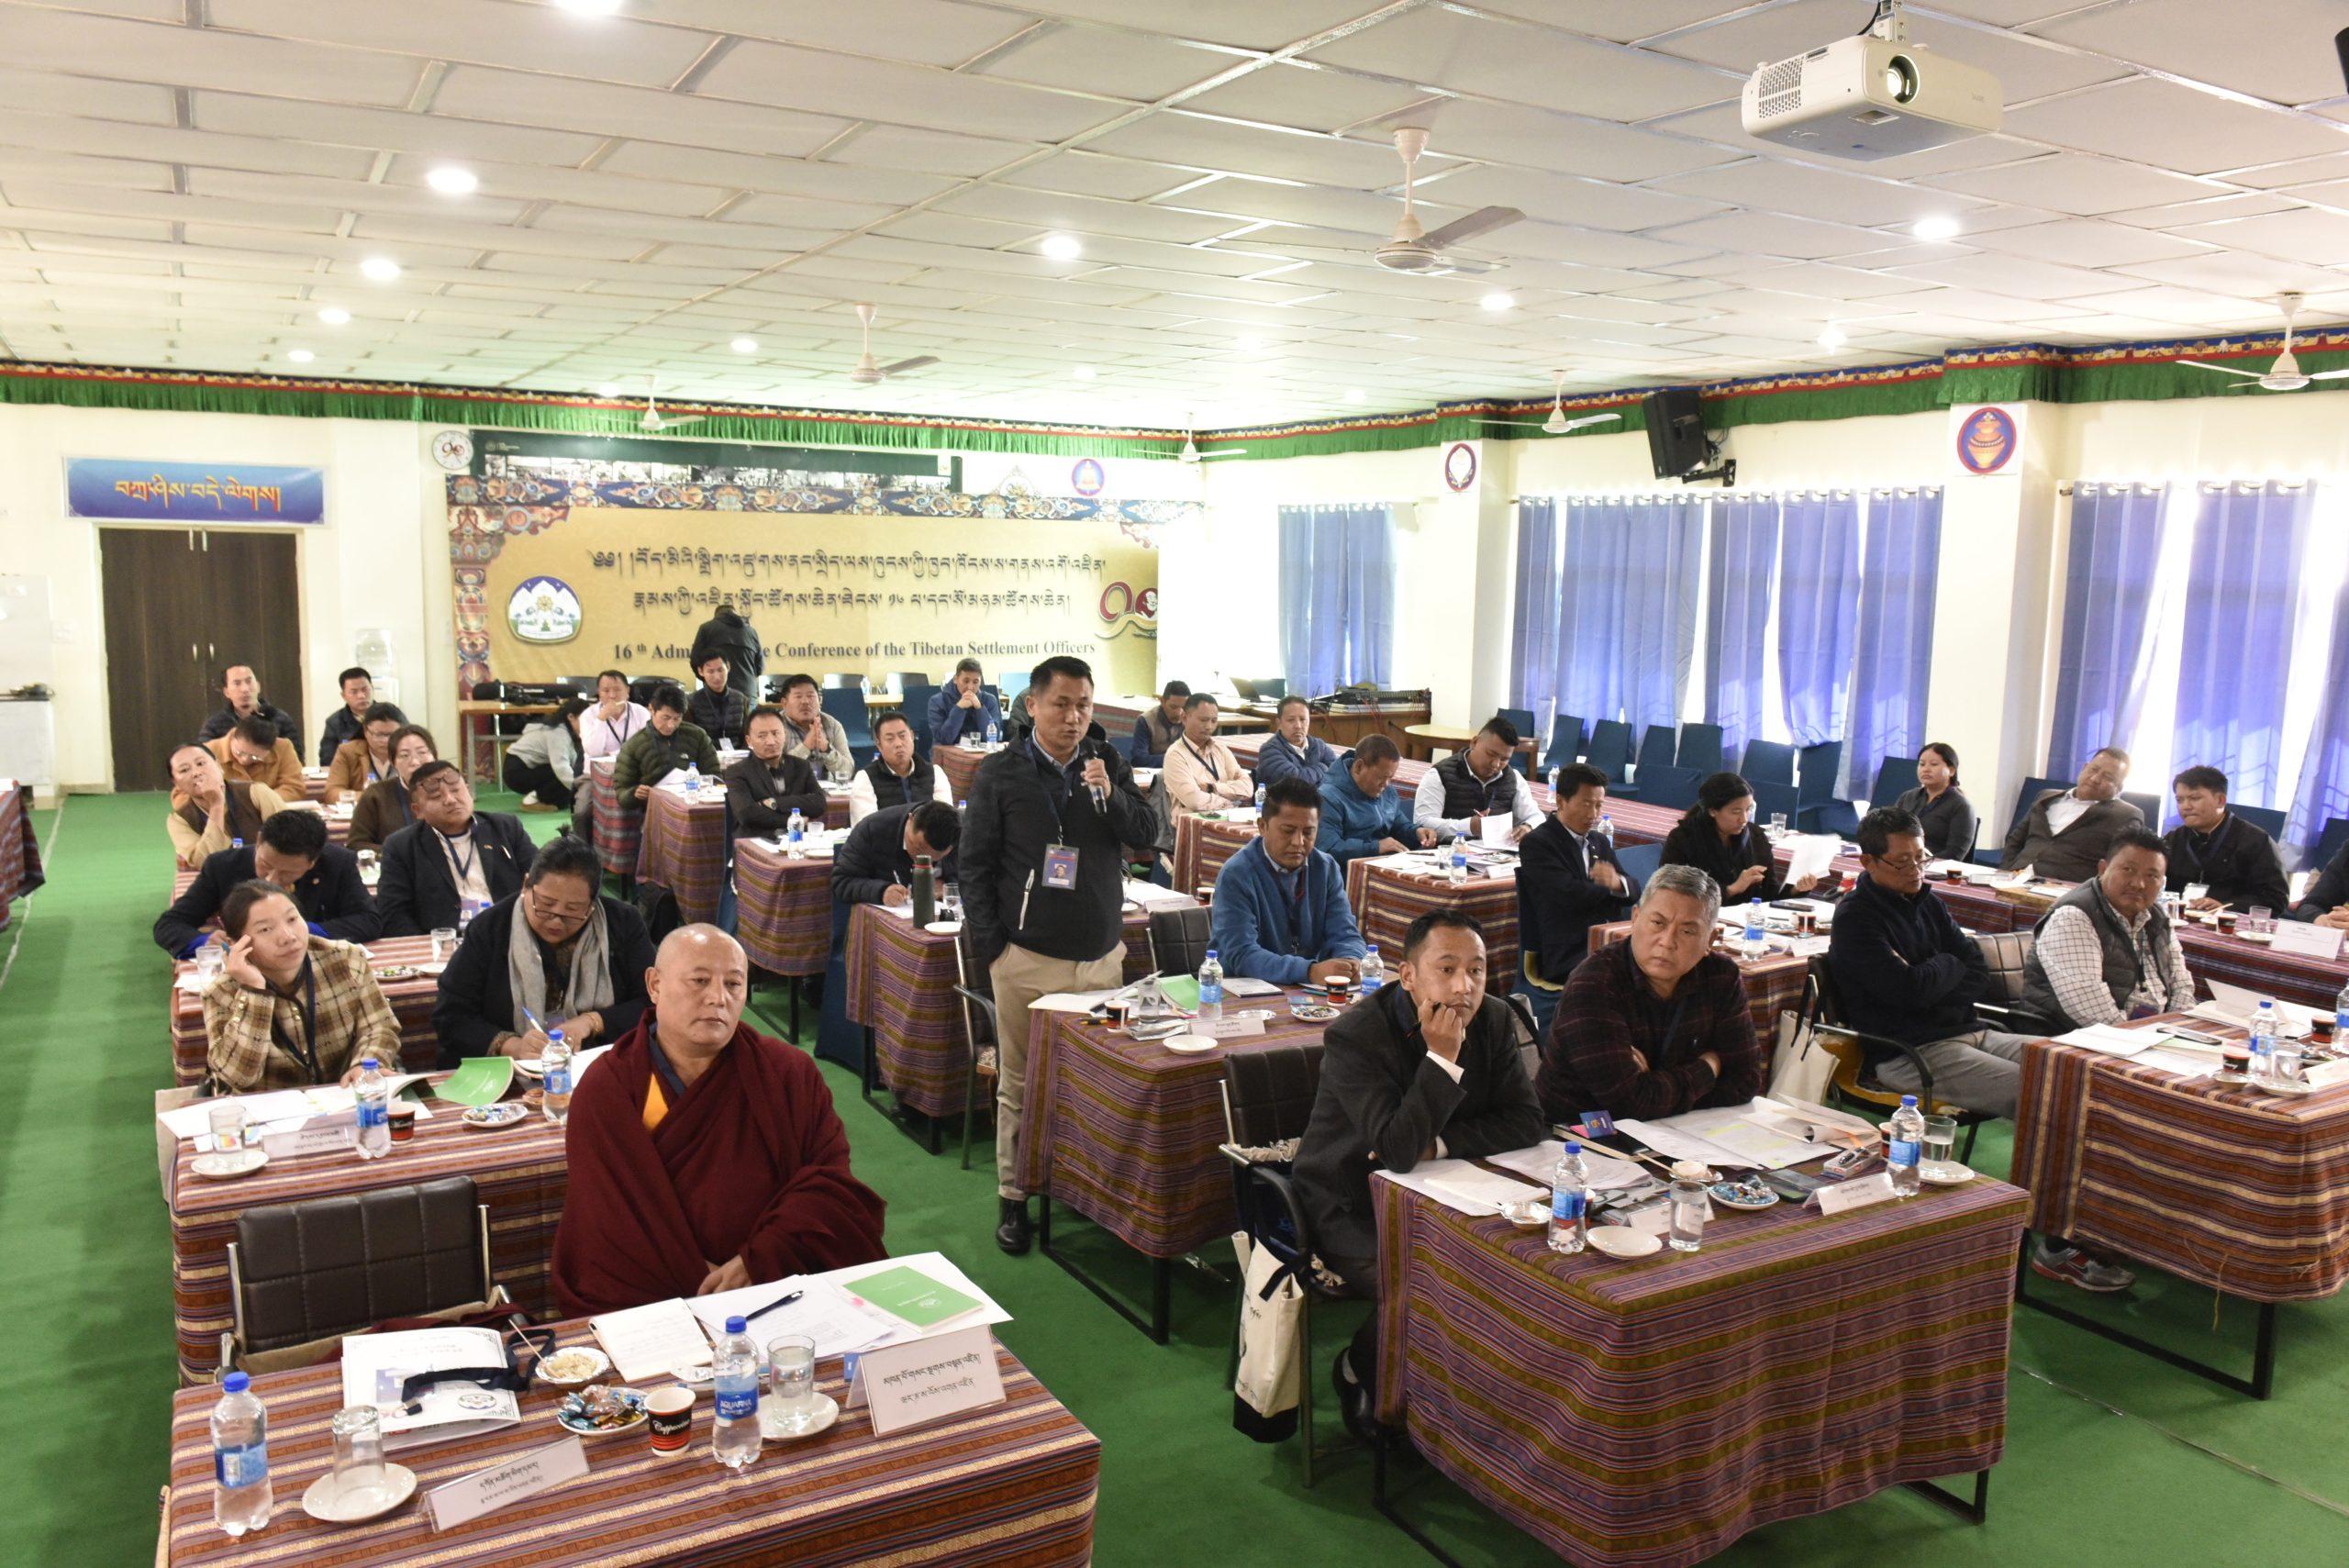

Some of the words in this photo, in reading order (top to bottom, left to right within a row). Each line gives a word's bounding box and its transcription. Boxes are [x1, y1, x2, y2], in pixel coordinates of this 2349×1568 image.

[615, 644, 632, 660] 16
[637, 643, 647, 653] th
[775, 642, 861, 659] Conference
[865, 642, 880, 657] of
[884, 641, 906, 657] the
[909, 641, 963, 656] Tibetan
[968, 639, 1039, 655] Settlement
[1043, 639, 1096, 654] Officers
